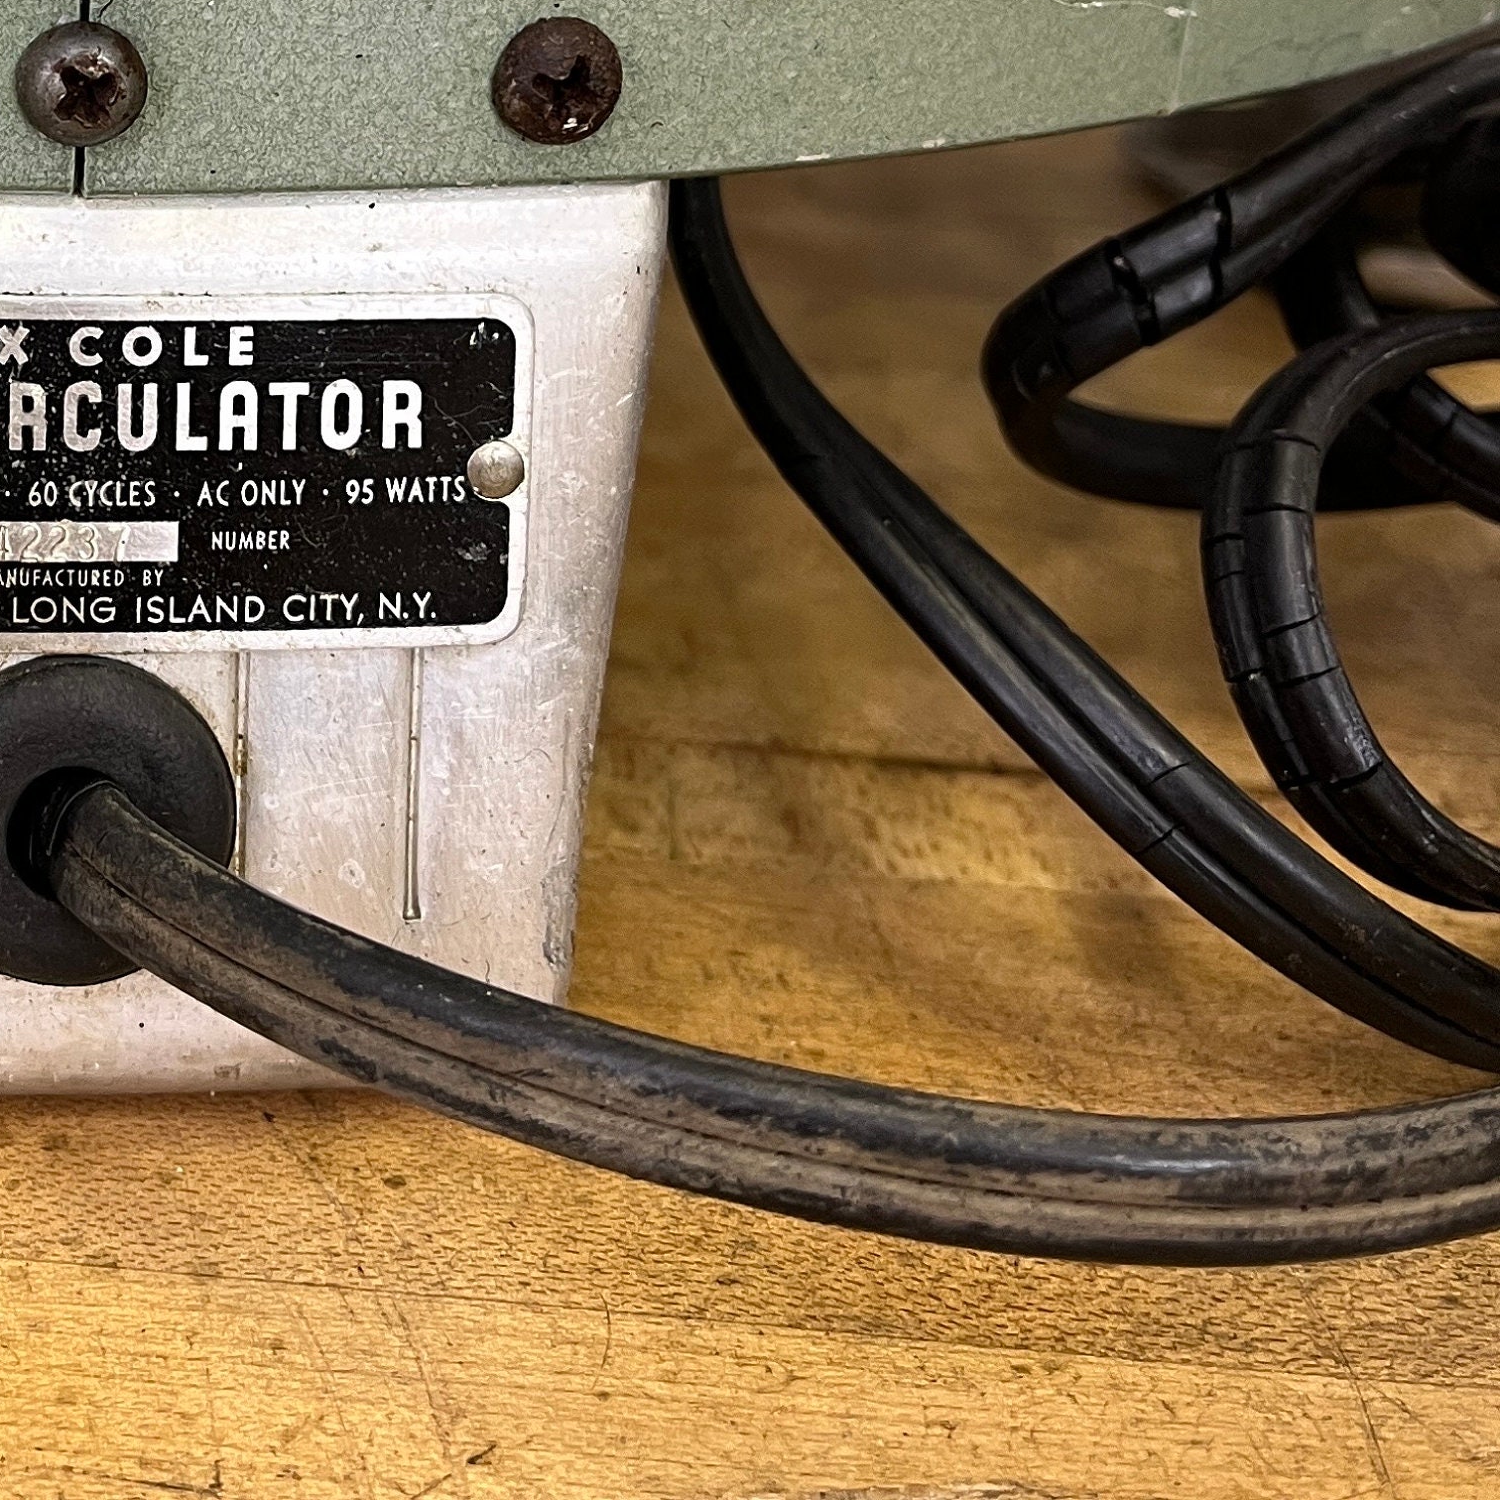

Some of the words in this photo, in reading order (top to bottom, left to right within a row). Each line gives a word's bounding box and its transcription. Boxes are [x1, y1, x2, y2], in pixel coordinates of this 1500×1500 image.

[68, 325, 255, 367] COLE
[28, 480, 58, 507] 60
[68, 479, 156, 507] CYCLES
[197, 480, 227, 507] AC
[240, 479, 306, 506] ONLY
[345, 478, 374, 505] 95
[386, 475, 466, 503] WATTS
[211, 530, 290, 551] NUMBER
[142, 568, 164, 587] BY
[12, 595, 117, 624] LONG
[135, 595, 265, 624] ISLAND
[282, 592, 365, 626] CITY,
[378, 590, 437, 620] N.Y.
